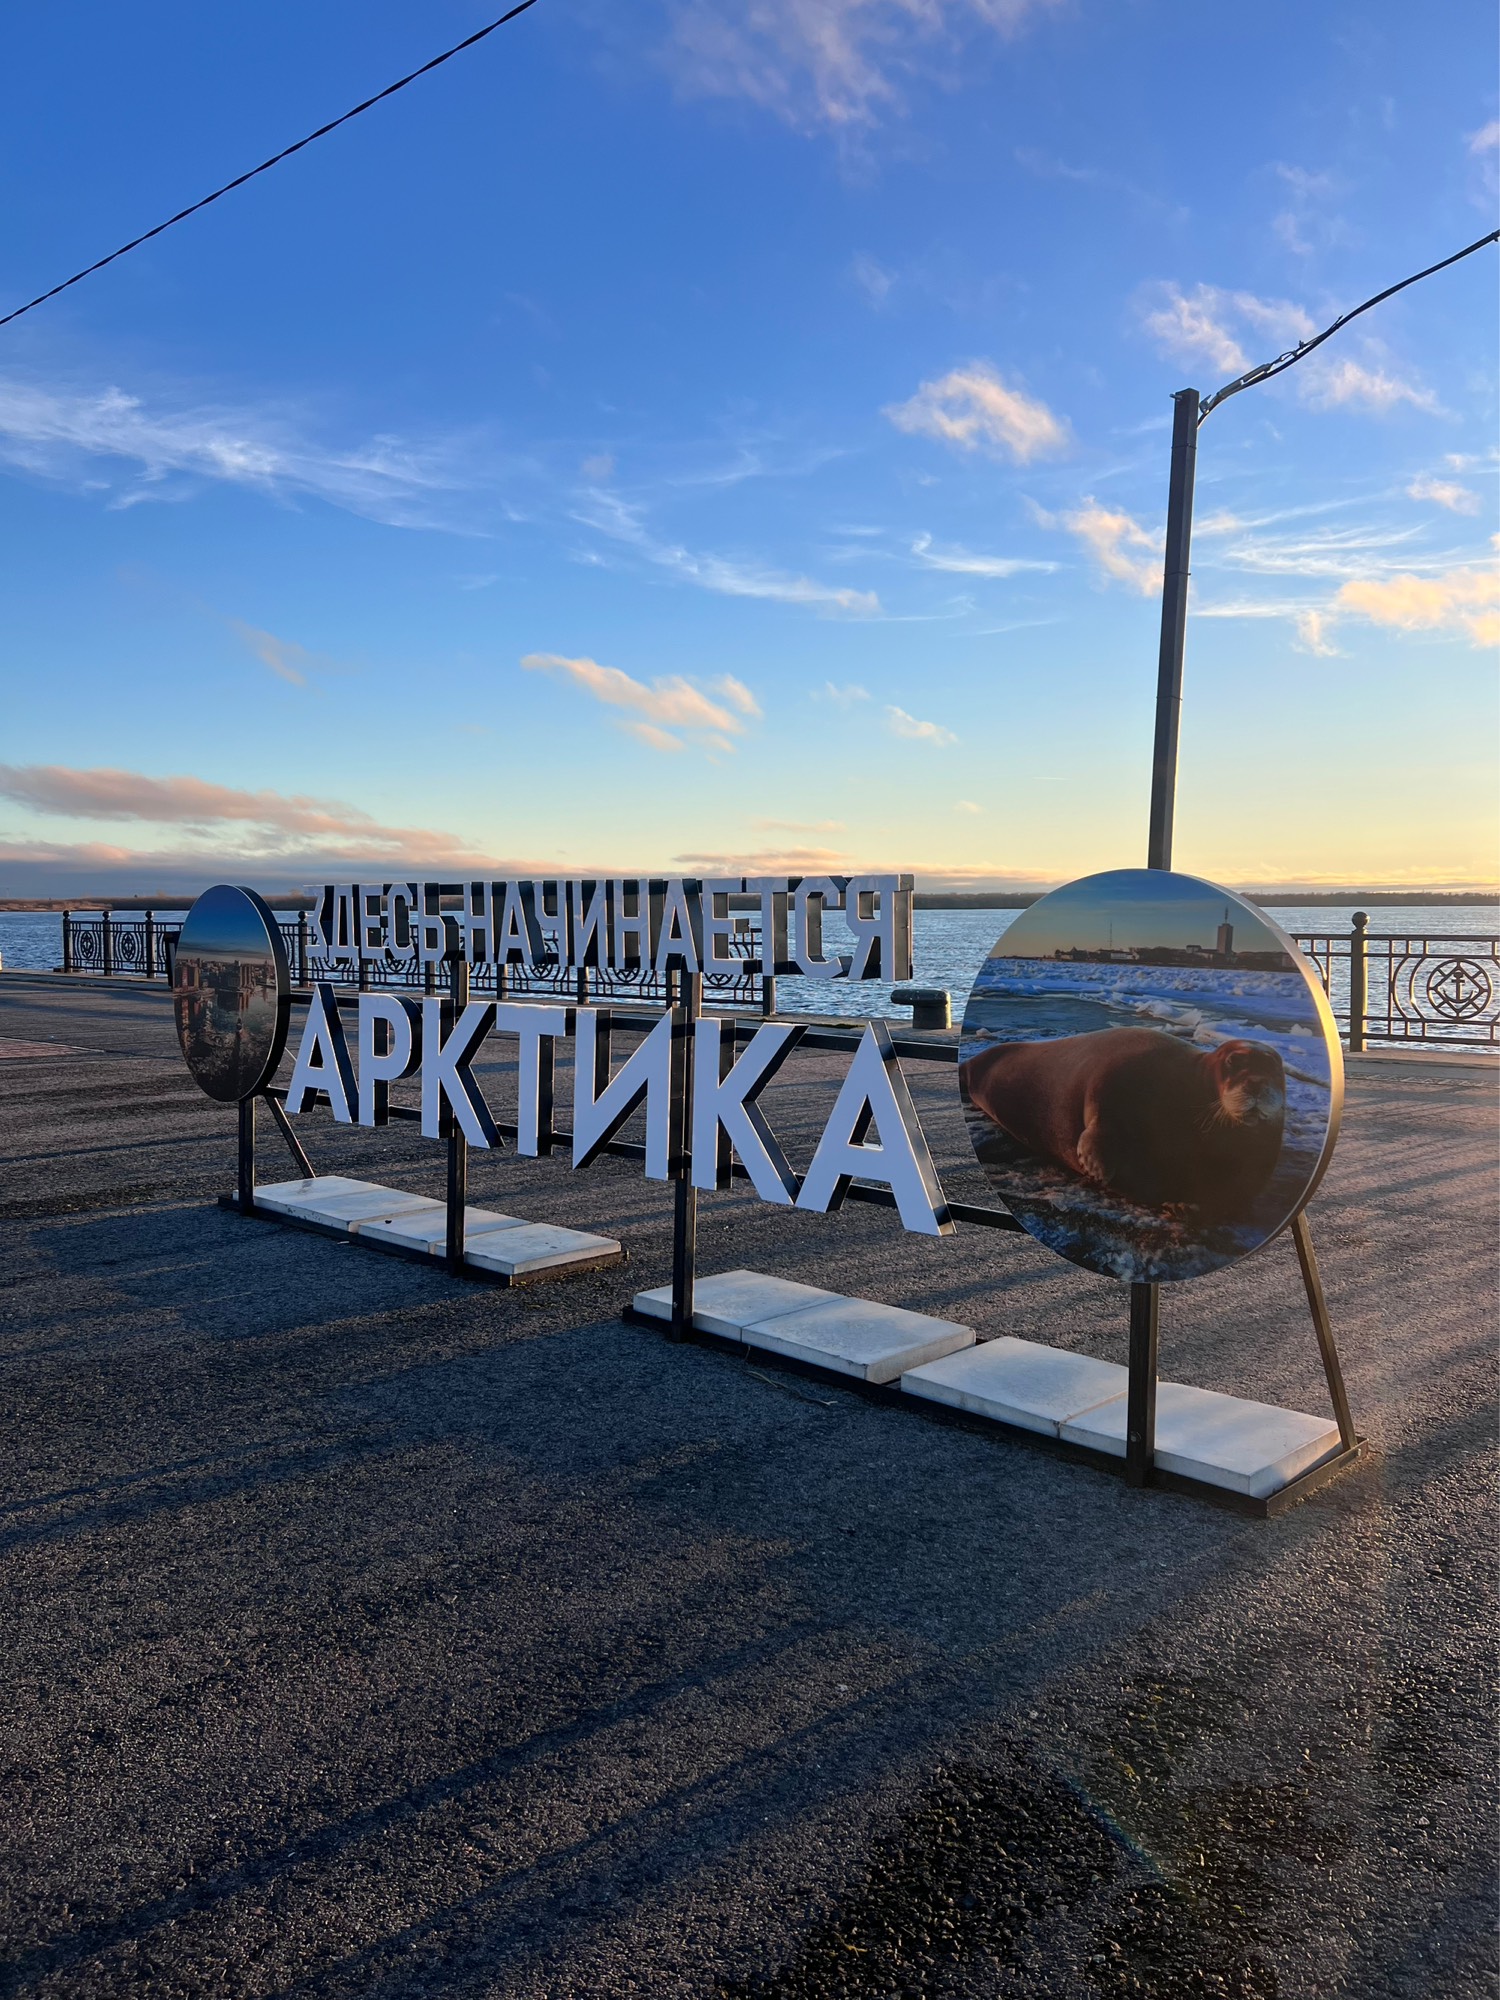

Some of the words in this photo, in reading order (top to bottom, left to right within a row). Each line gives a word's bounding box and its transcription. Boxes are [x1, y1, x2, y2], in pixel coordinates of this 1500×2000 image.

[303, 882, 448, 965] ЗДЕСЬ
[463, 874, 905, 981] НАЧИНАЕТСЯ
[285, 983, 952, 1236] АРКТИКА
